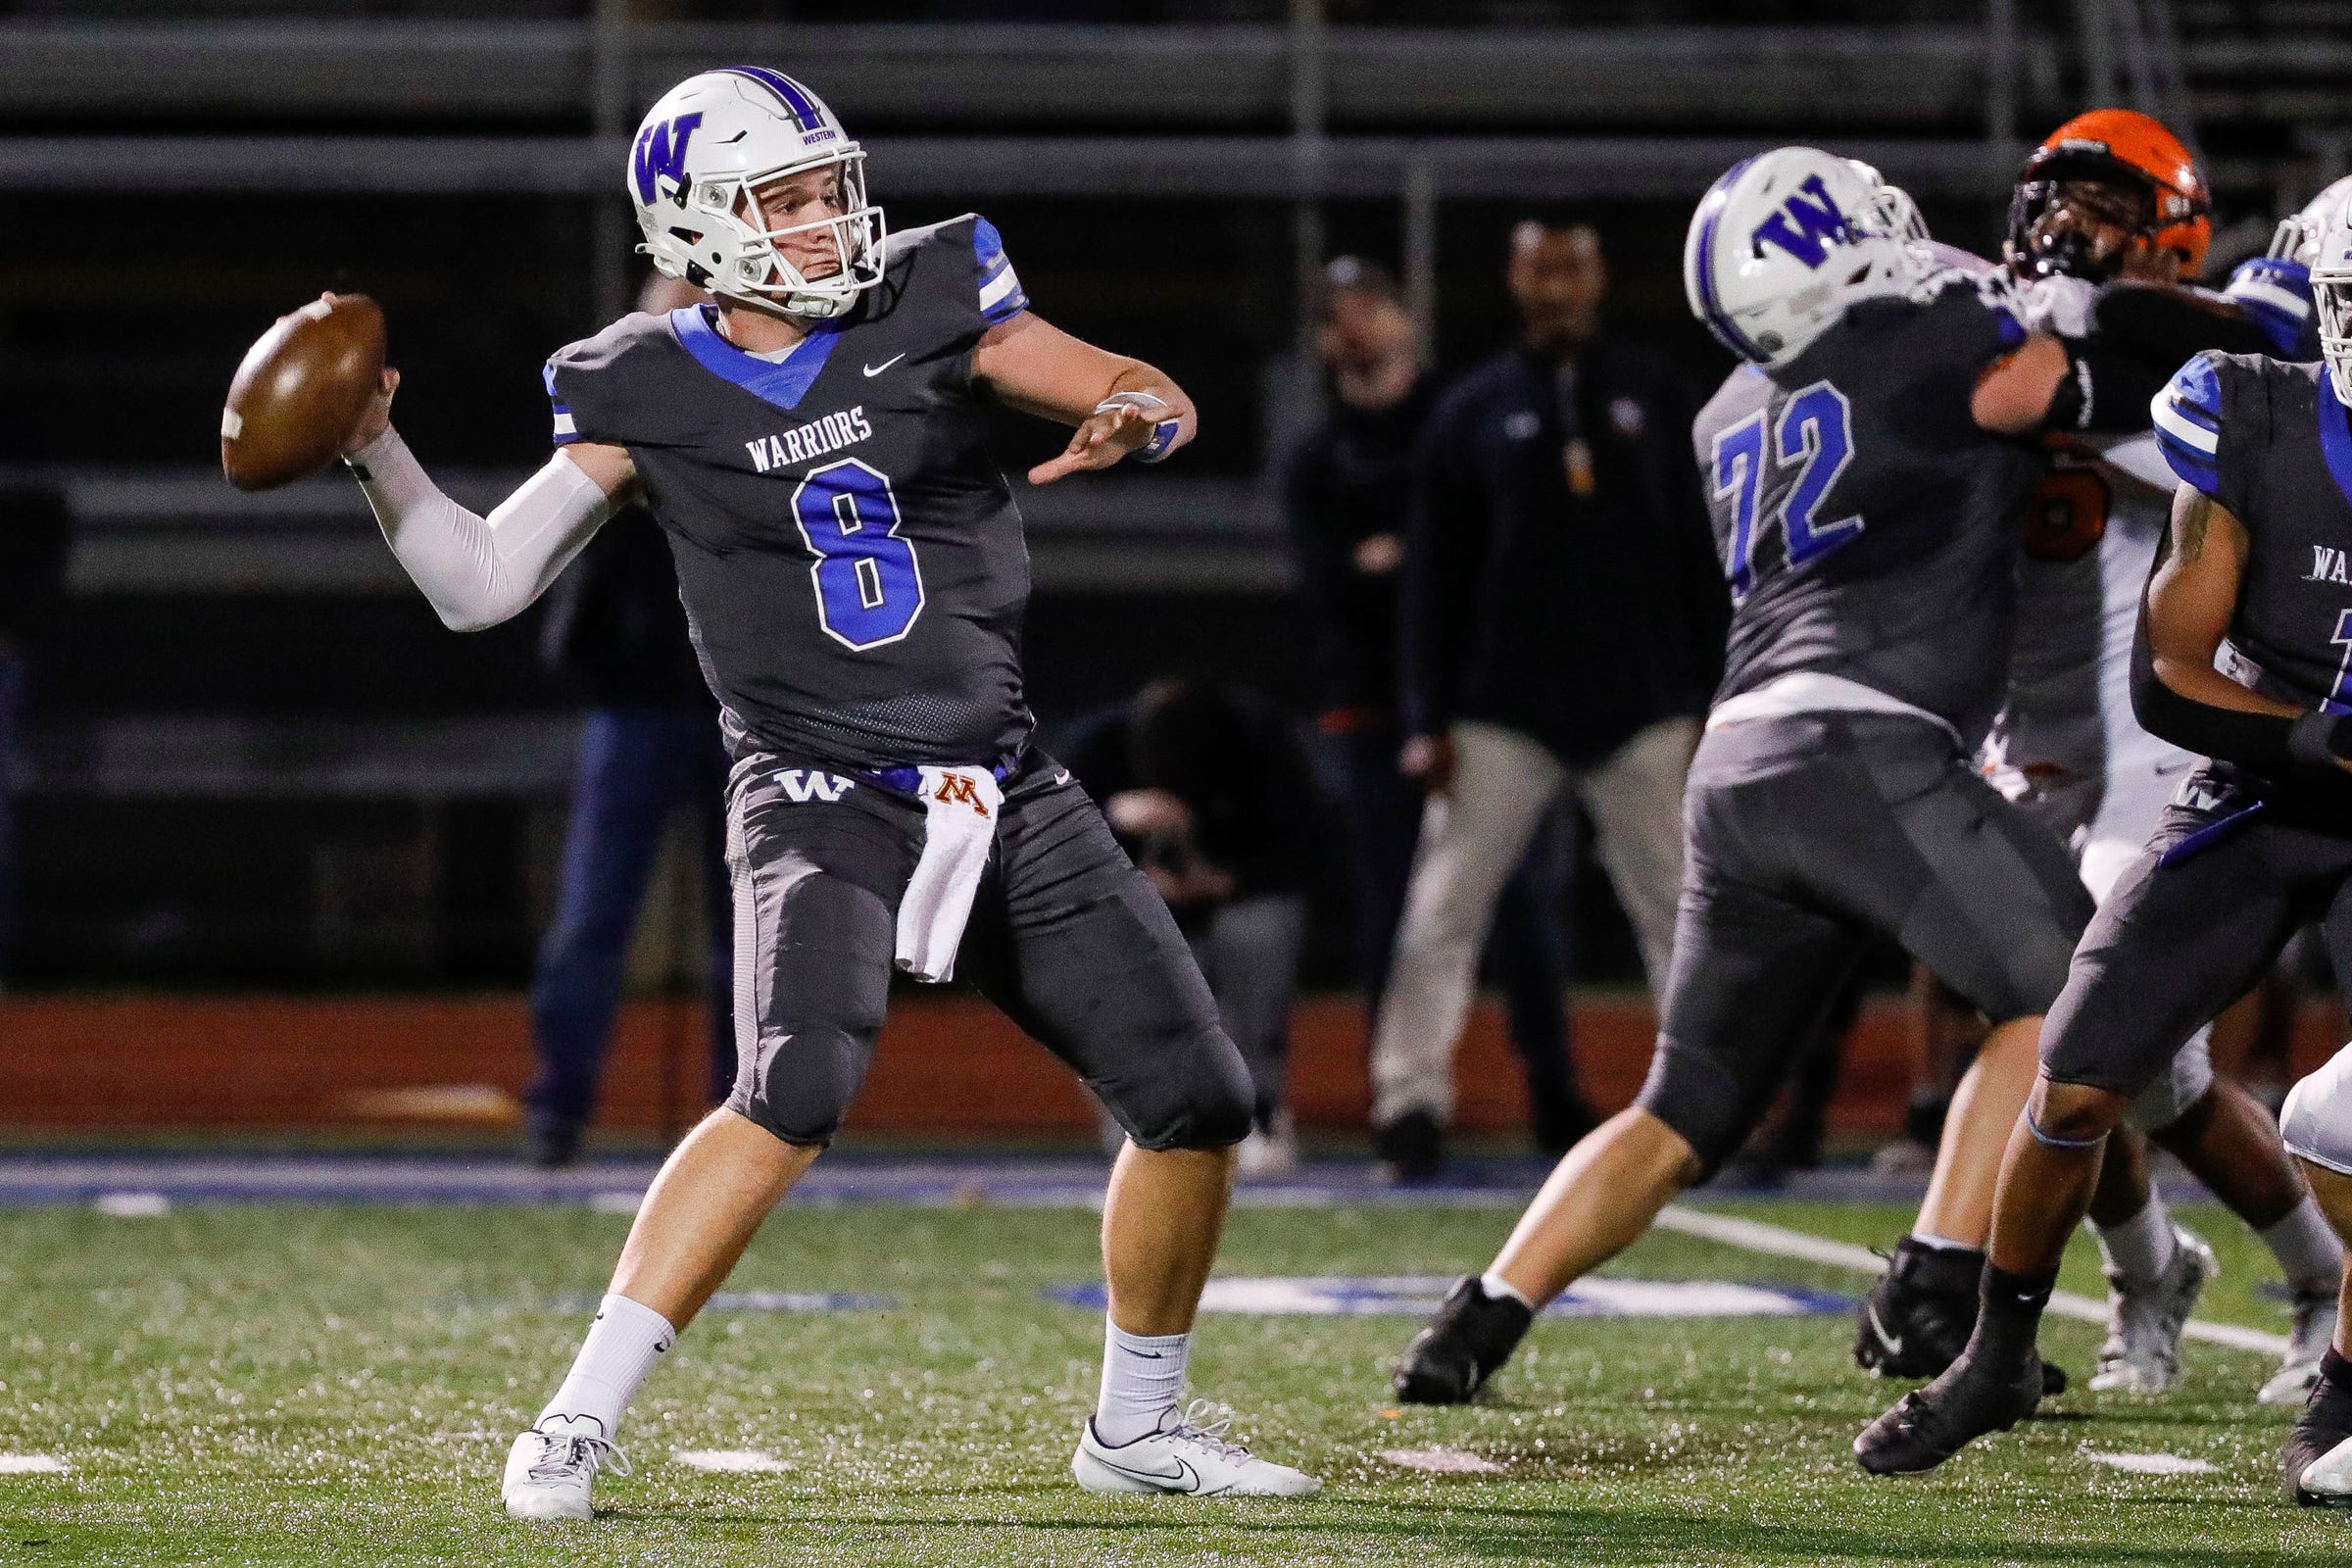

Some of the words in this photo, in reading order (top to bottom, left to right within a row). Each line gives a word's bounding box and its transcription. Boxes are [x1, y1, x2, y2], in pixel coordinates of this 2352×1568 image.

[634, 111, 704, 207] W
[802, 129, 836, 145] WESTERN
[1752, 173, 1845, 269] W
[746, 406, 873, 472] WARRIORS
[1712, 379, 1865, 608] 72
[790, 457, 925, 652] 8
[2313, 545, 2352, 585] WA
[773, 769, 856, 802] W
[935, 772, 991, 818] M
